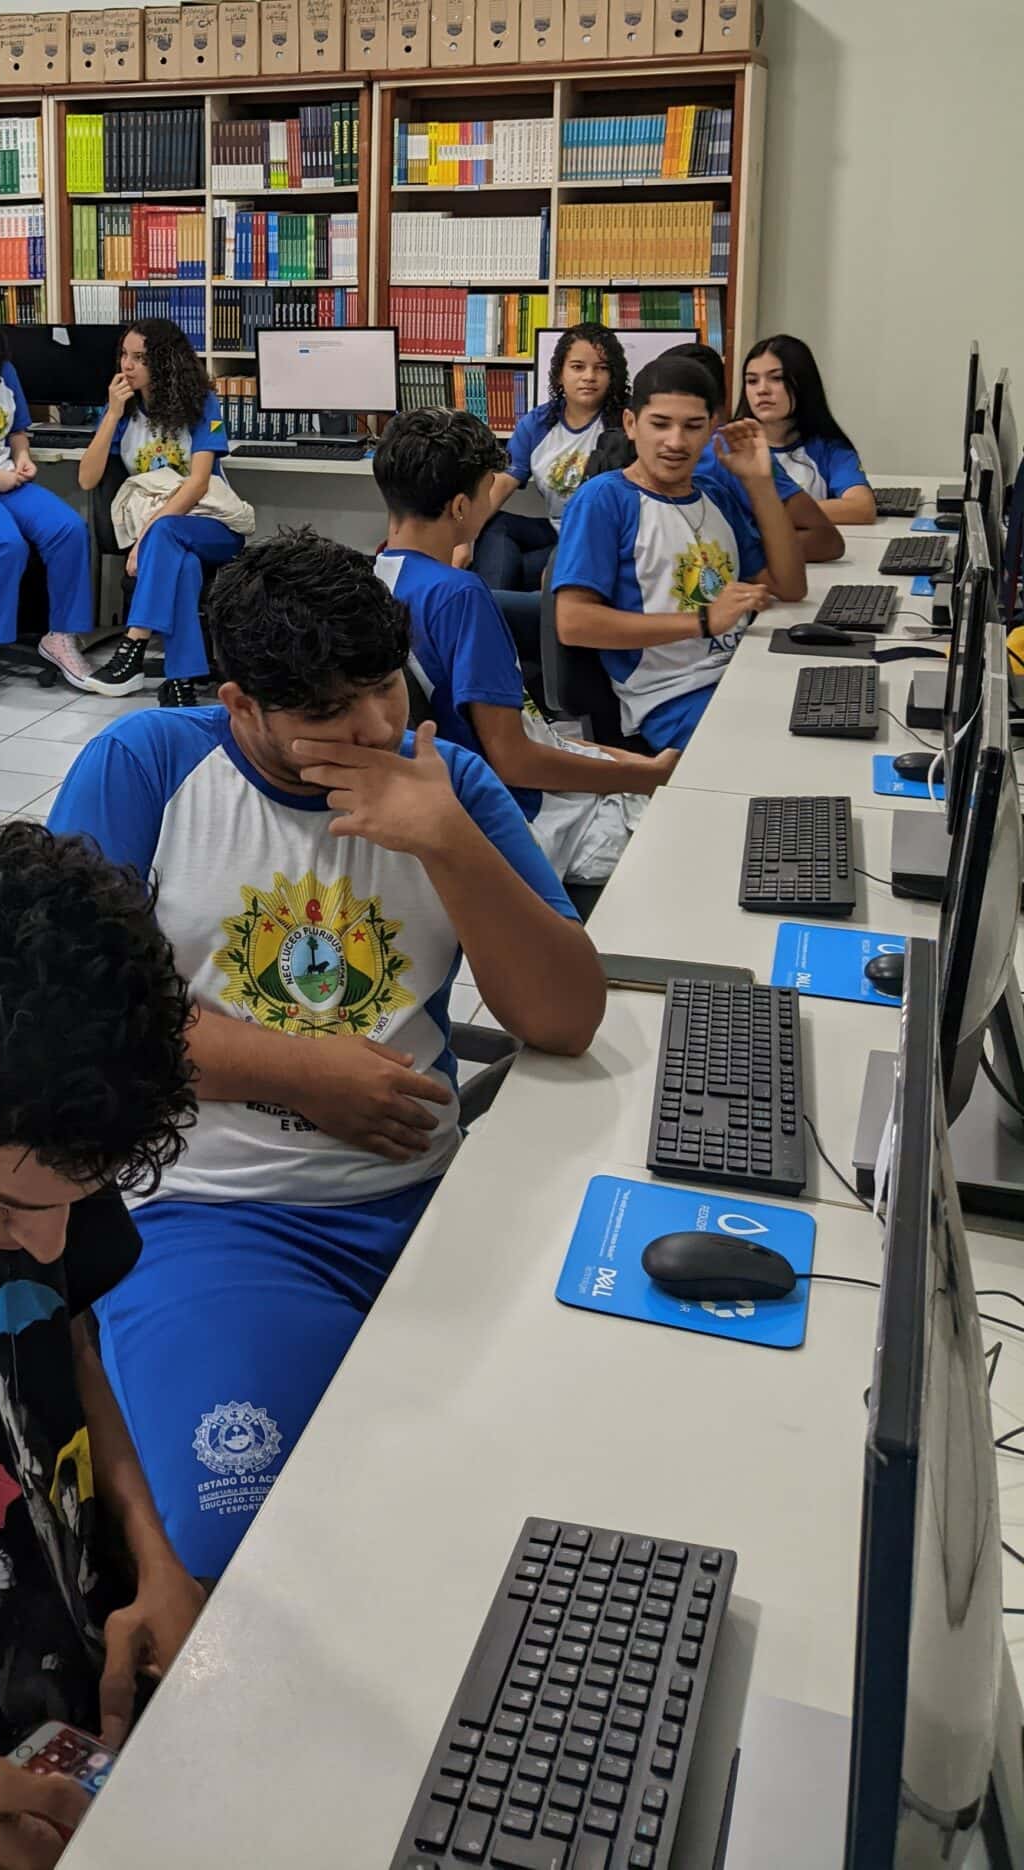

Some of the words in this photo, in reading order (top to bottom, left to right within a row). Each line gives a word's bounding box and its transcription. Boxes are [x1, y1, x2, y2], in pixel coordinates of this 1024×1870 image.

[281, 931, 302, 961] LUCEO
[303, 926, 342, 953] PLURIBUS
[282, 964, 294, 985] NEC
[280, 1119, 290, 1131] E
[592, 1267, 617, 1297] DELL
[197, 1477, 237, 1493] ESTADO
[240, 1475, 255, 1484] DO
[219, 1507, 224, 1515] E
[226, 1504, 260, 1514] ESPORT
